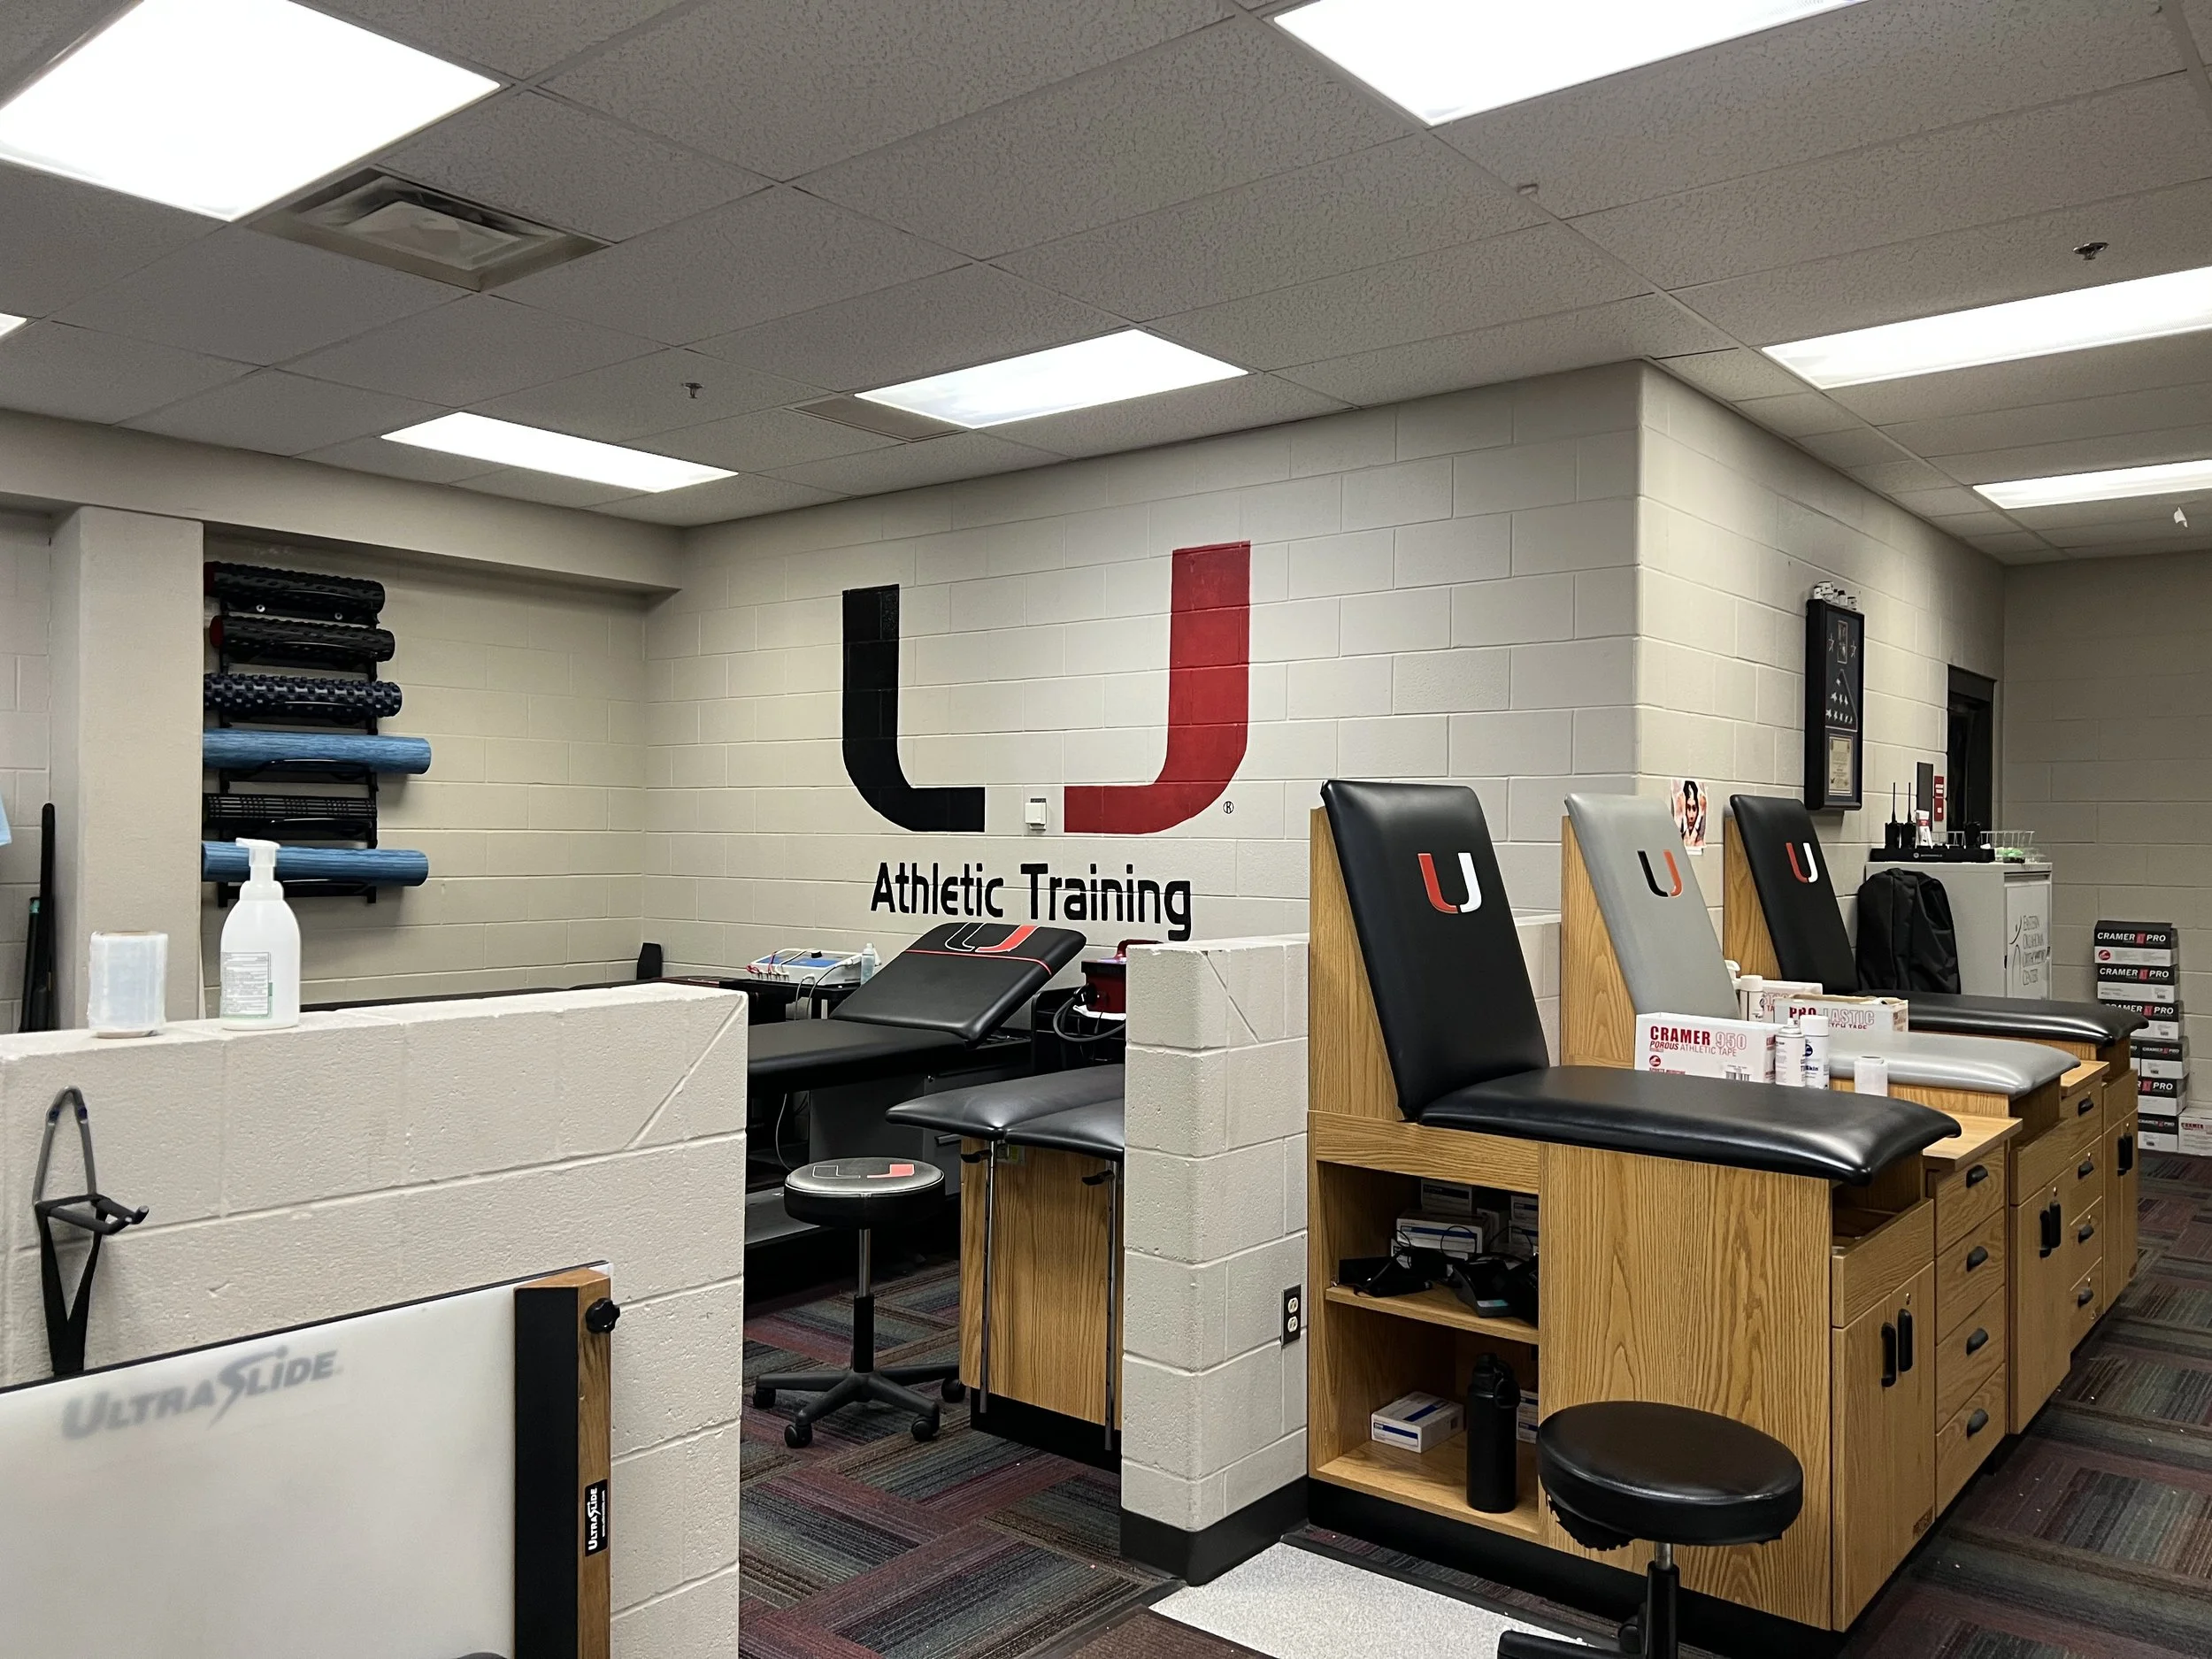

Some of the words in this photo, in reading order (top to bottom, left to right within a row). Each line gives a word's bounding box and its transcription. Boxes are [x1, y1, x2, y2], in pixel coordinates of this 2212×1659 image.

[871, 861, 1004, 918] Athletic
[1020, 863, 1192, 941] Training
[2097, 932, 2135, 941] CRAMER
[2099, 967, 2139, 976] CRAMER
[2105, 1003, 2143, 1012] AMER
[1649, 1025, 1711, 1046] CRAMER
[1716, 1032, 1747, 1050] 950
[1649, 1041, 1679, 1051] POROUS
[1679, 1044, 1717, 1055] ATHLETIC
[1718, 1048, 1737, 1057] TAPE
